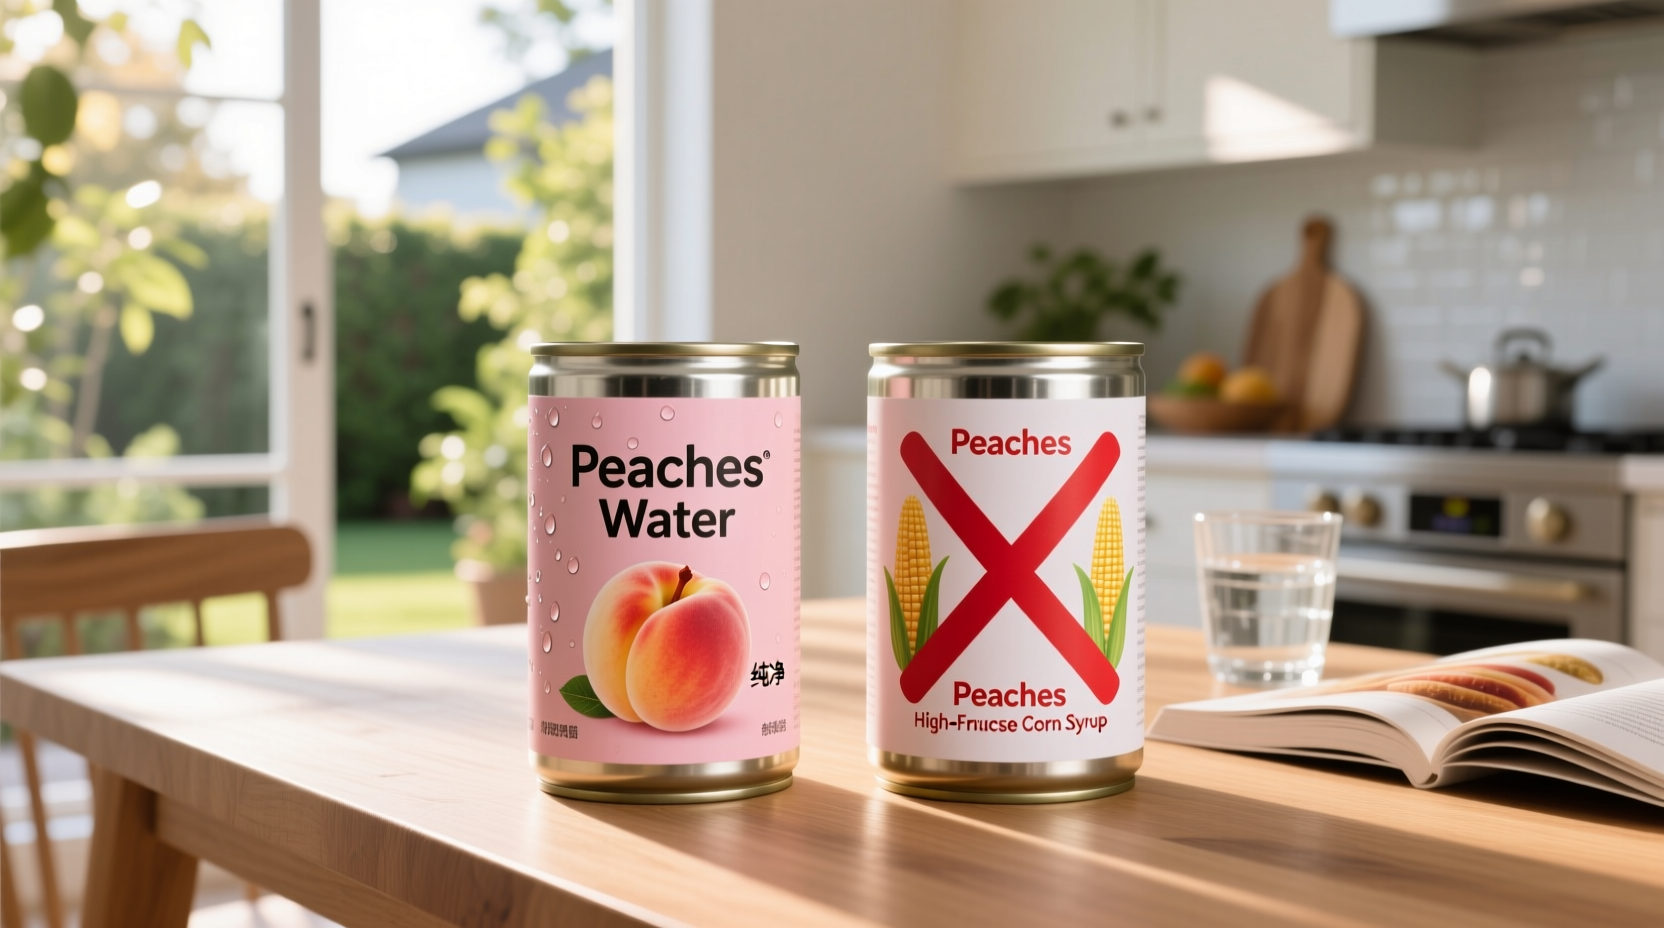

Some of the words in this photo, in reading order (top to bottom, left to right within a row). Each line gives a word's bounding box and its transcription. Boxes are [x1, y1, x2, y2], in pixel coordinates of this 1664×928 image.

[951, 427, 1072, 456] Peaches
[599, 498, 736, 539] Water
[750, 660, 785, 688] 纯净
[953, 680, 1067, 708] Peaches
[1021, 714, 1062, 733] Corn
[1065, 713, 1108, 736] Syrup
